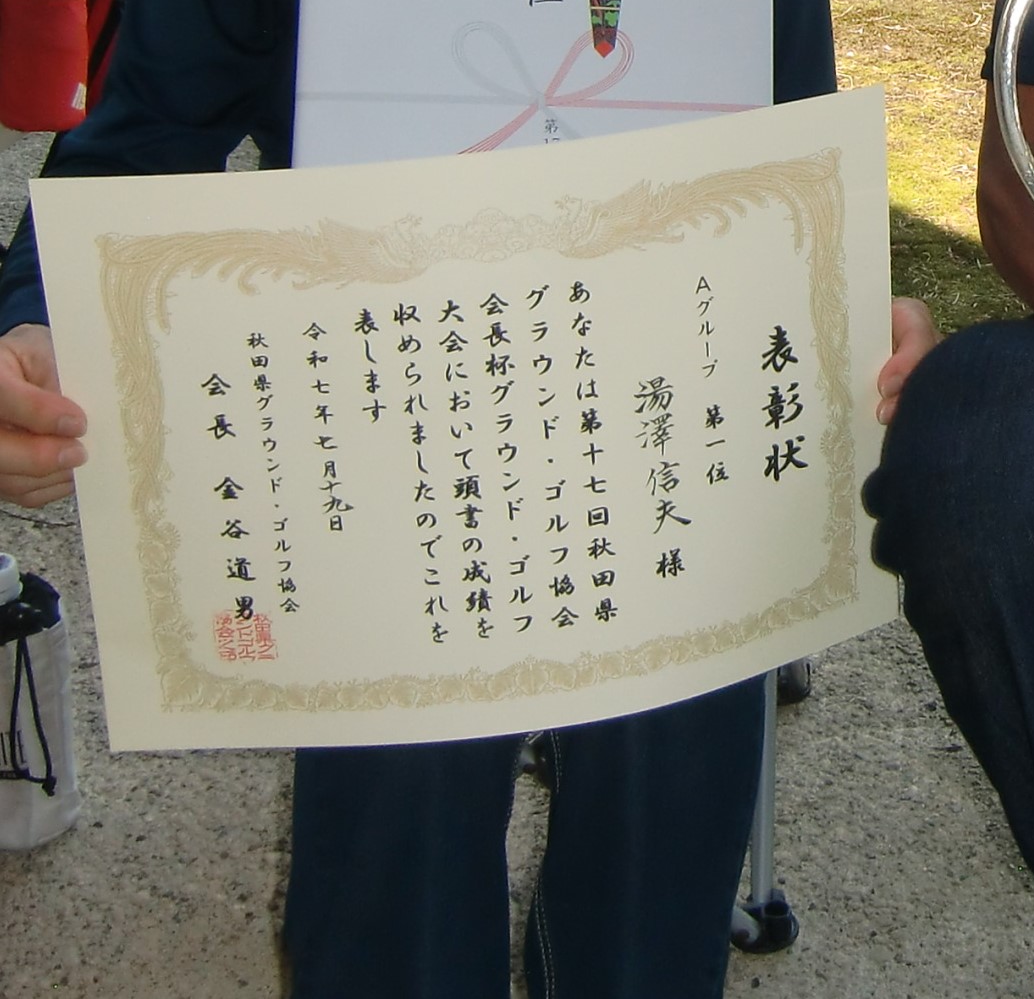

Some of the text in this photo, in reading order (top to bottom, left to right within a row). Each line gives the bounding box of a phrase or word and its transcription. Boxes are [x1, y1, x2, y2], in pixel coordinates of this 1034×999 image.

[200, 372, 257, 621] 会長 金谷道男
[246, 332, 300, 613] 秋田県グラウンド・ゴルフ協会
[301, 321, 355, 532] 令和七年七月十九日
[354, 307, 387, 424] 表します
[392, 302, 449, 643] 収められましたのでこれを
[437, 299, 495, 640] 大会において頭書の成績を
[479, 292, 534, 633] 会長杯グラウンド・ゴルフ
[525, 284, 580, 629] グラウンド・ゴルフ協会
[568, 280, 618, 623] あなたは第十七回秋田県
[633, 375, 692, 579] 湯澤信夫 様
[695, 275, 730, 485] Aグループ 第一位
[761, 324, 809, 482] 表彰状
